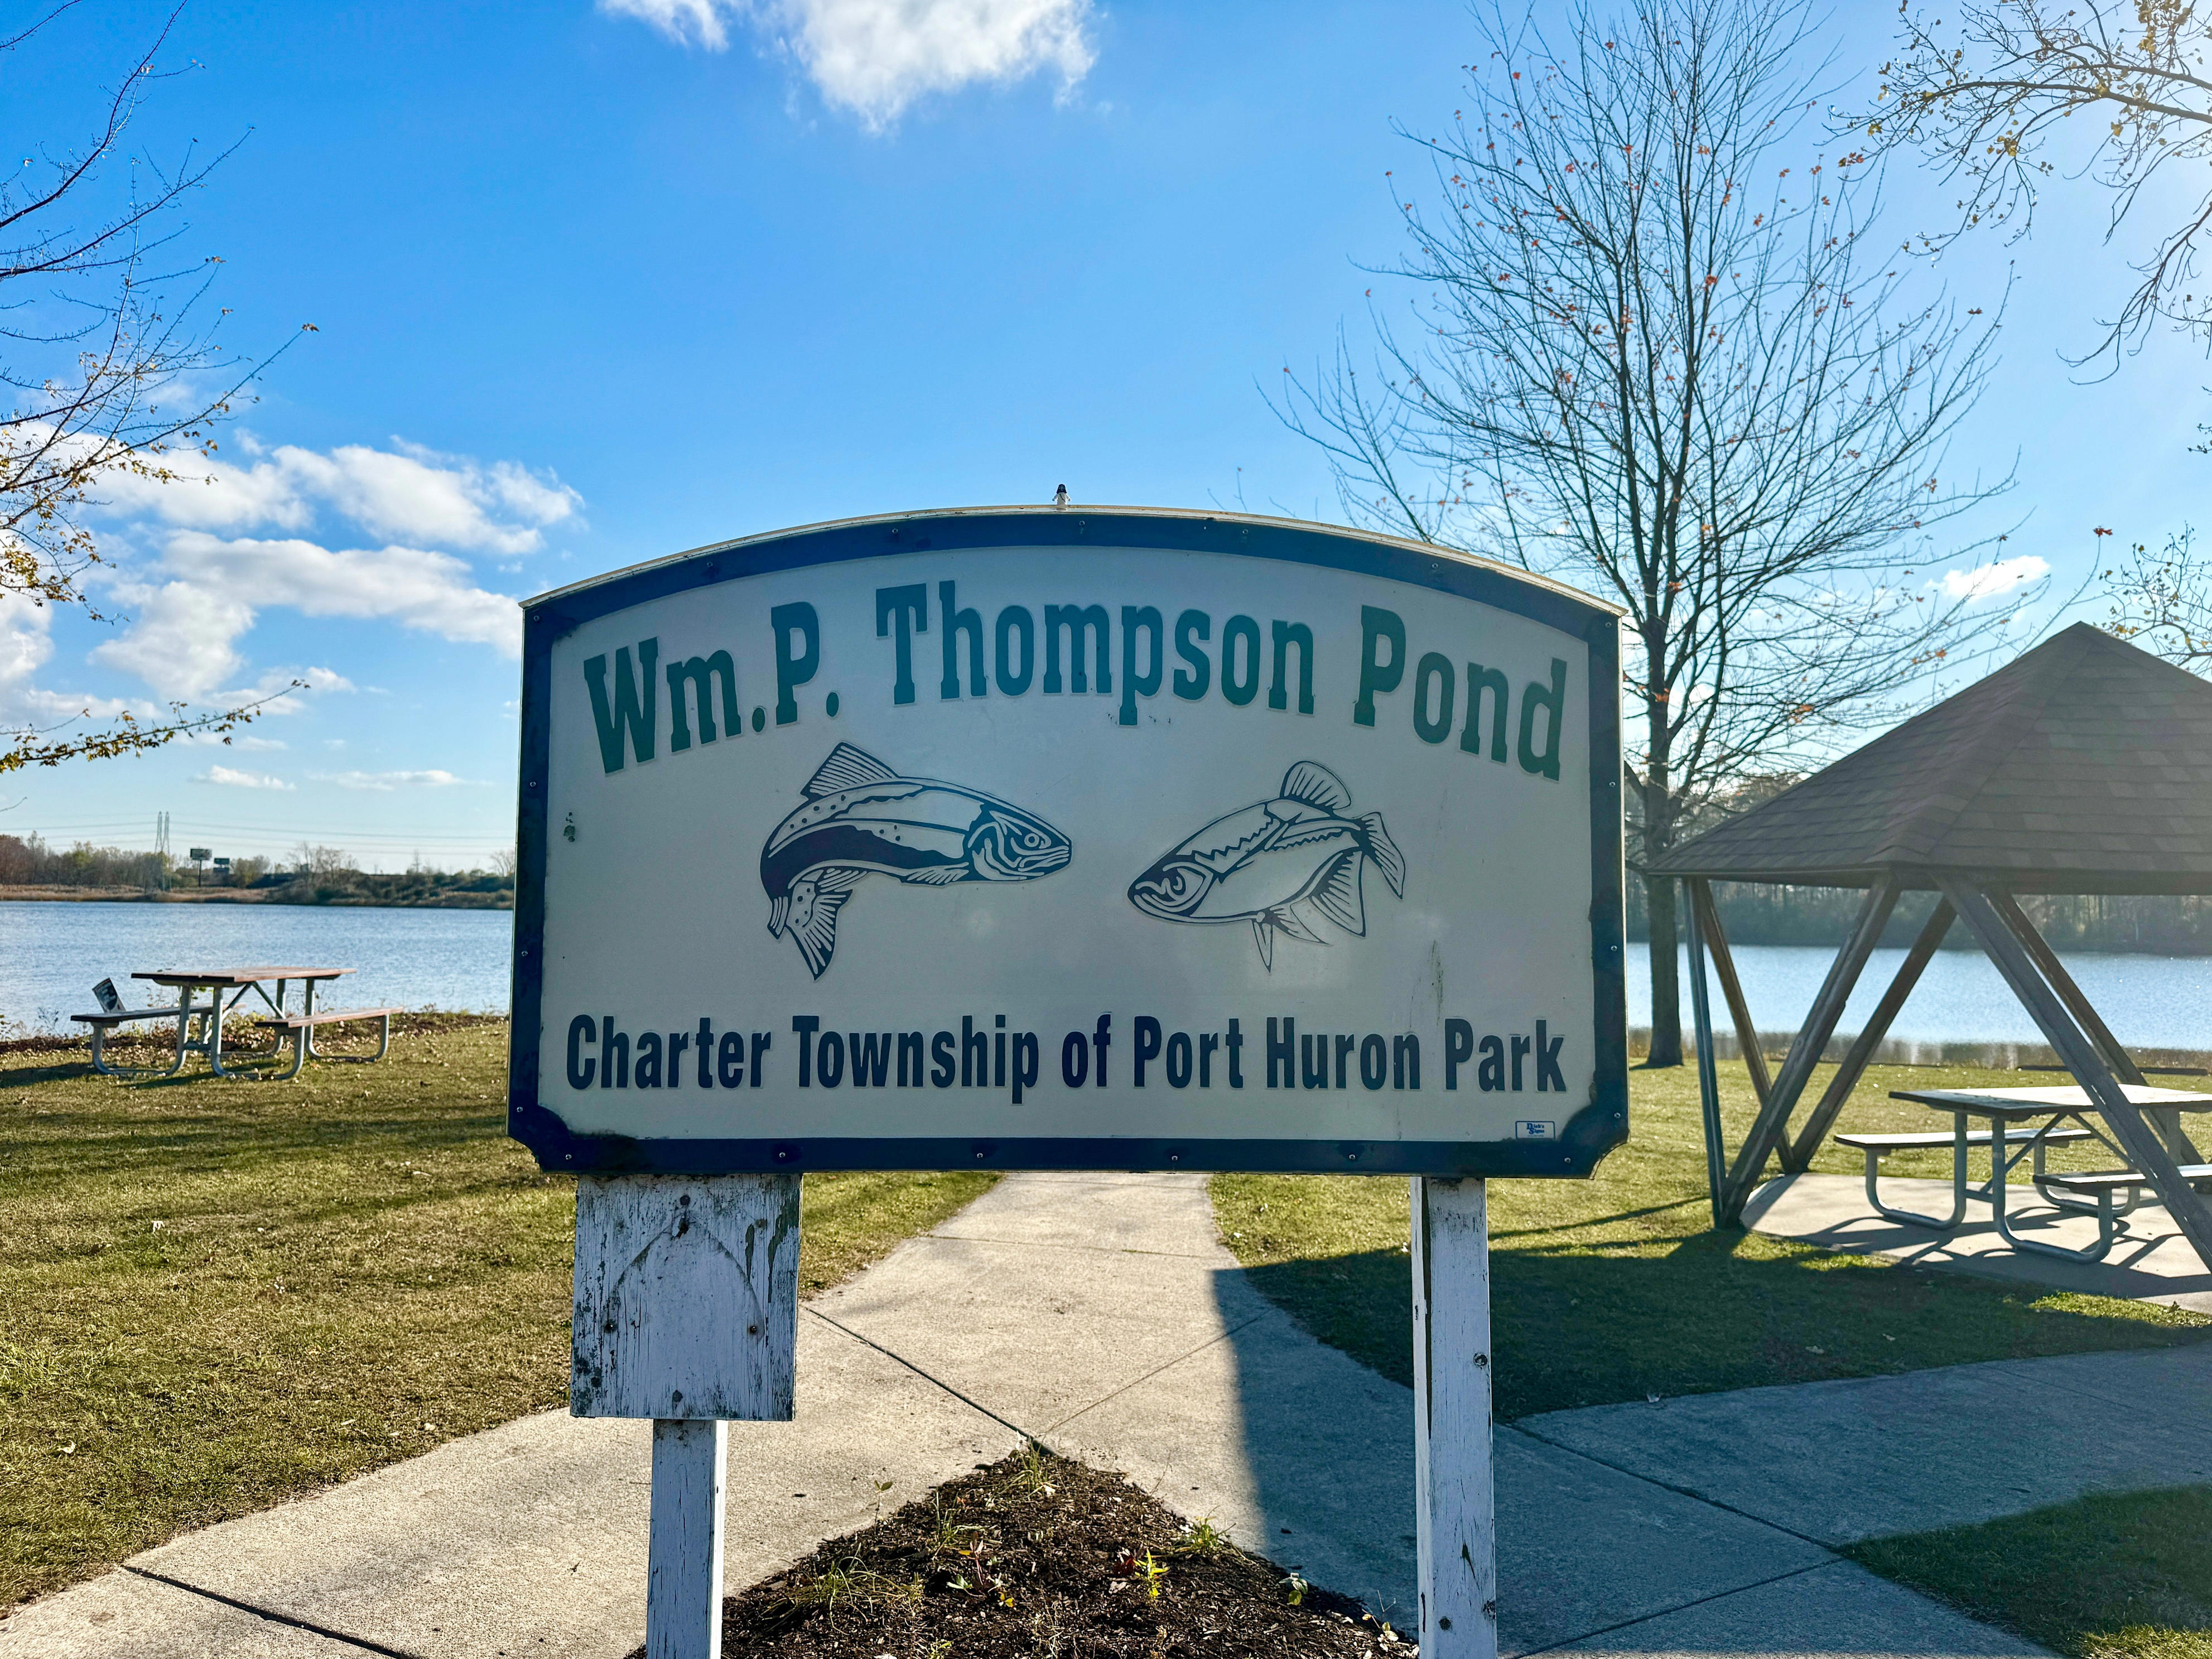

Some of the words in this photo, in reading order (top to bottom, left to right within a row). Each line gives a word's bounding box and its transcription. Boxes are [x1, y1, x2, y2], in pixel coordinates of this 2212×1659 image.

[875, 580, 1314, 726] Thompson
[1354, 605, 1567, 781] Pond
[567, 1014, 771, 1089] Charter
[792, 1014, 1039, 1105] Township
[1062, 1014, 1111, 1088] of
[1134, 1016, 1244, 1088] Port
[1266, 1017, 1420, 1091] Huron
[1445, 1018, 1567, 1092] Park
